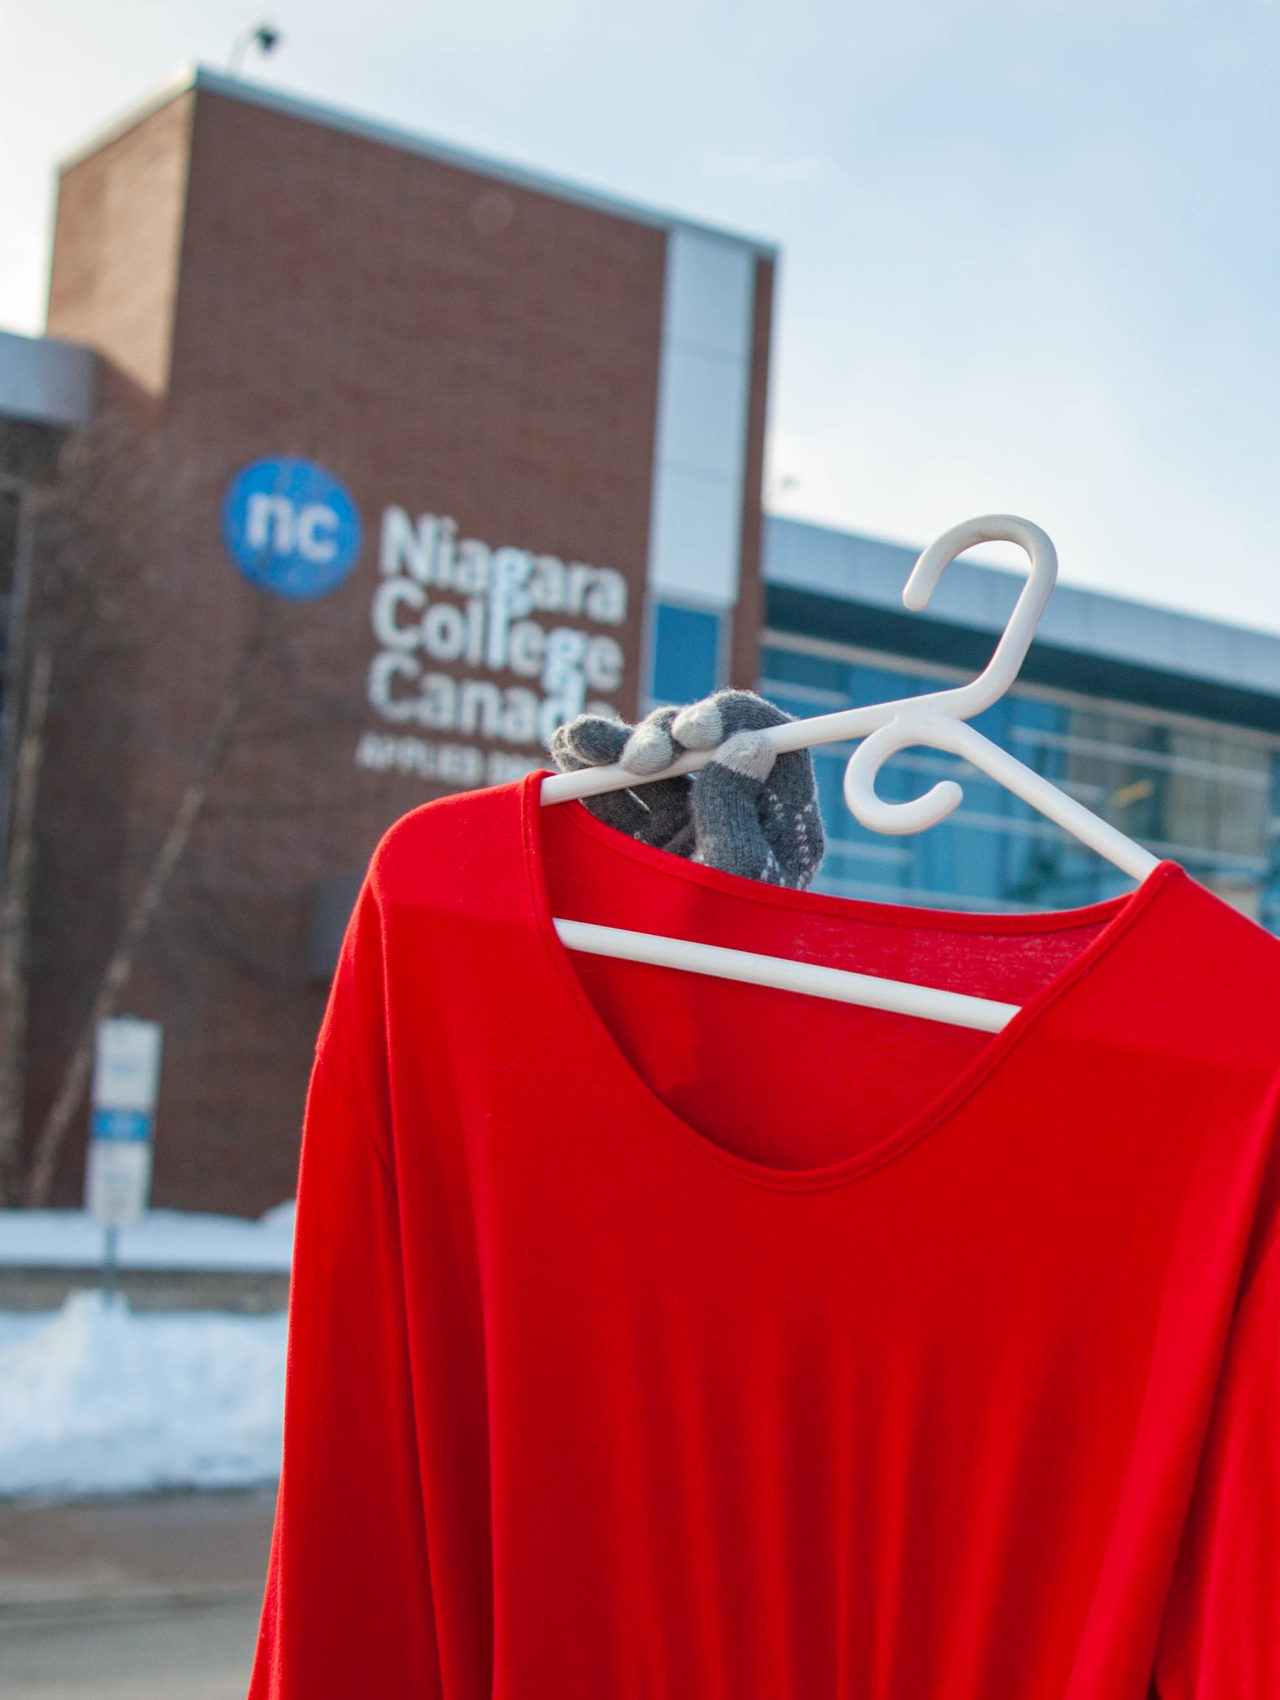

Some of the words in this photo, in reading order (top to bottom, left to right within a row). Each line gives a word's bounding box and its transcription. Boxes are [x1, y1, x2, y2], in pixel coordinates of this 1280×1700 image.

[247, 492, 339, 563] nc
[379, 505, 628, 625] Niagara
[371, 576, 625, 702] College
